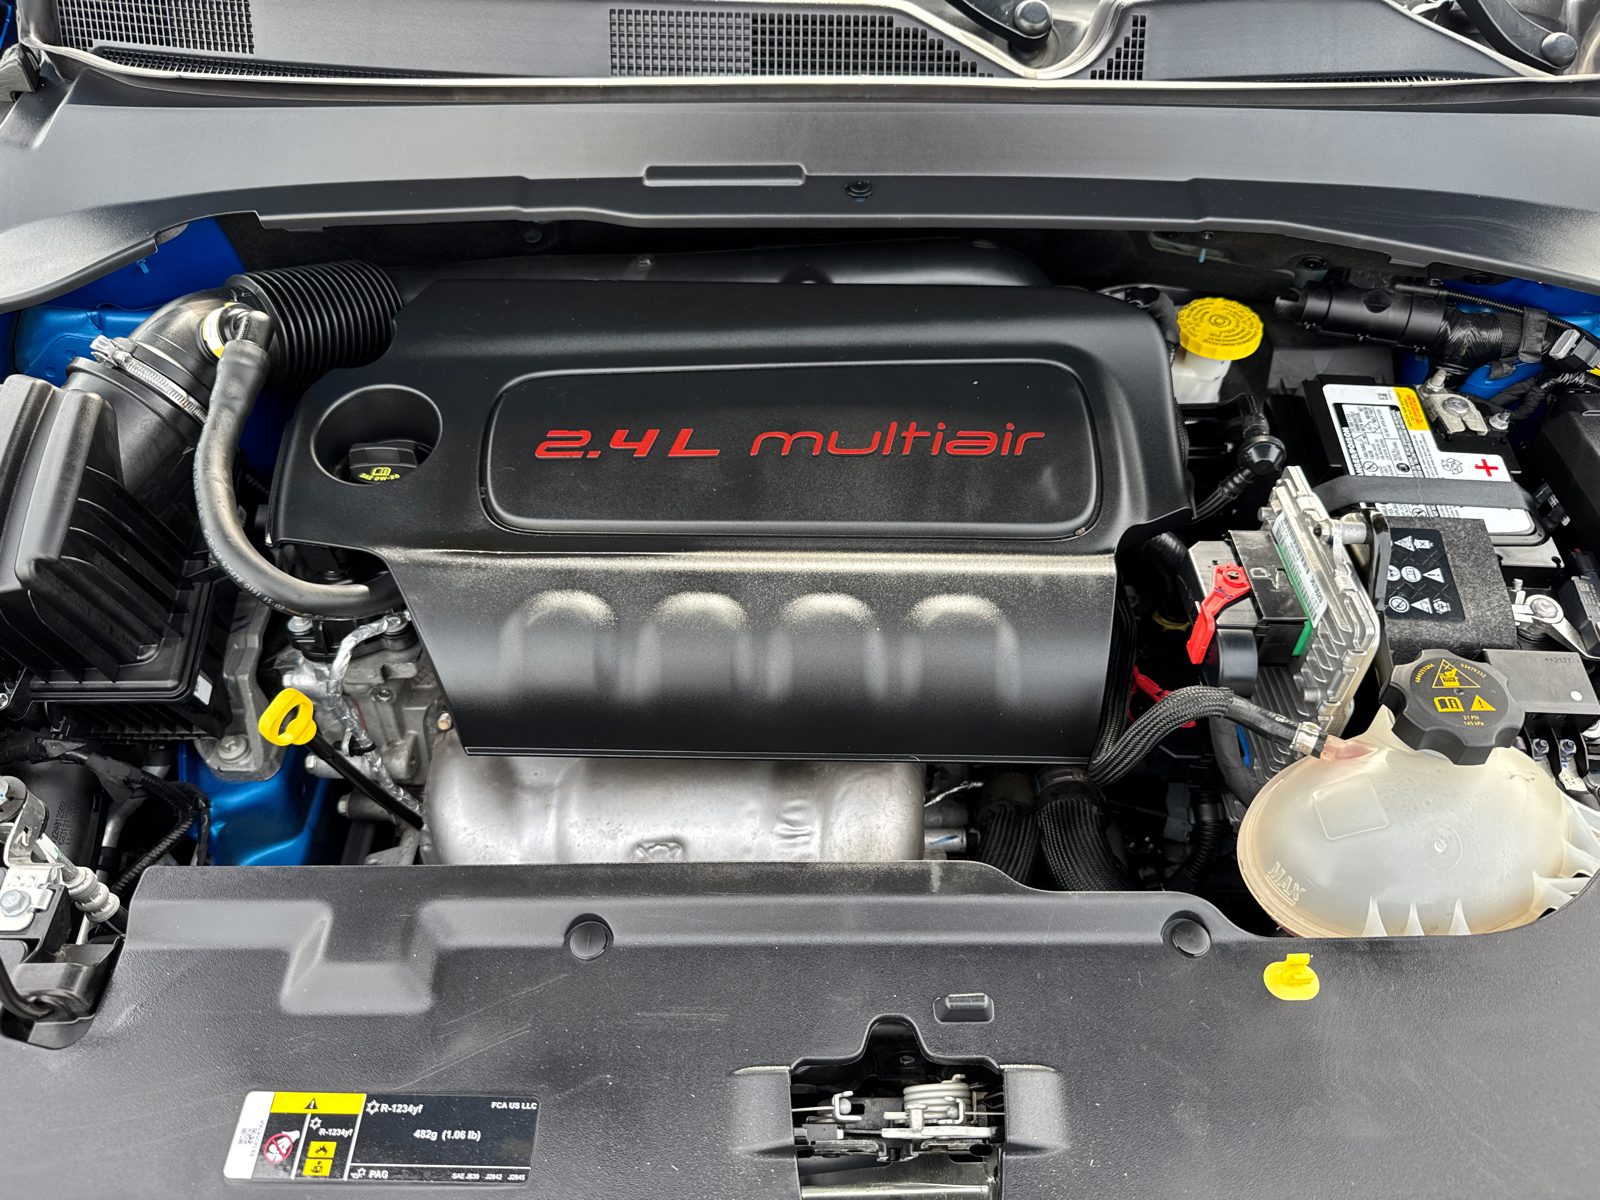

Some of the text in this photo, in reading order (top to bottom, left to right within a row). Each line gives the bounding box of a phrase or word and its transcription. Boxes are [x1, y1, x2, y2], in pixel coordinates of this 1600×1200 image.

[750, 421, 1045, 456] multiair
[1268, 861, 1306, 901] MAX
[380, 1103, 423, 1115] R-1234yf
[491, 1101, 507, 1110] FCA
[509, 1102, 520, 1110] US
[319, 1127, 354, 1137] R-1234yf
[413, 1129, 481, 1141] 482g (1.06 lb)
[368, 1170, 388, 1179] PAG
